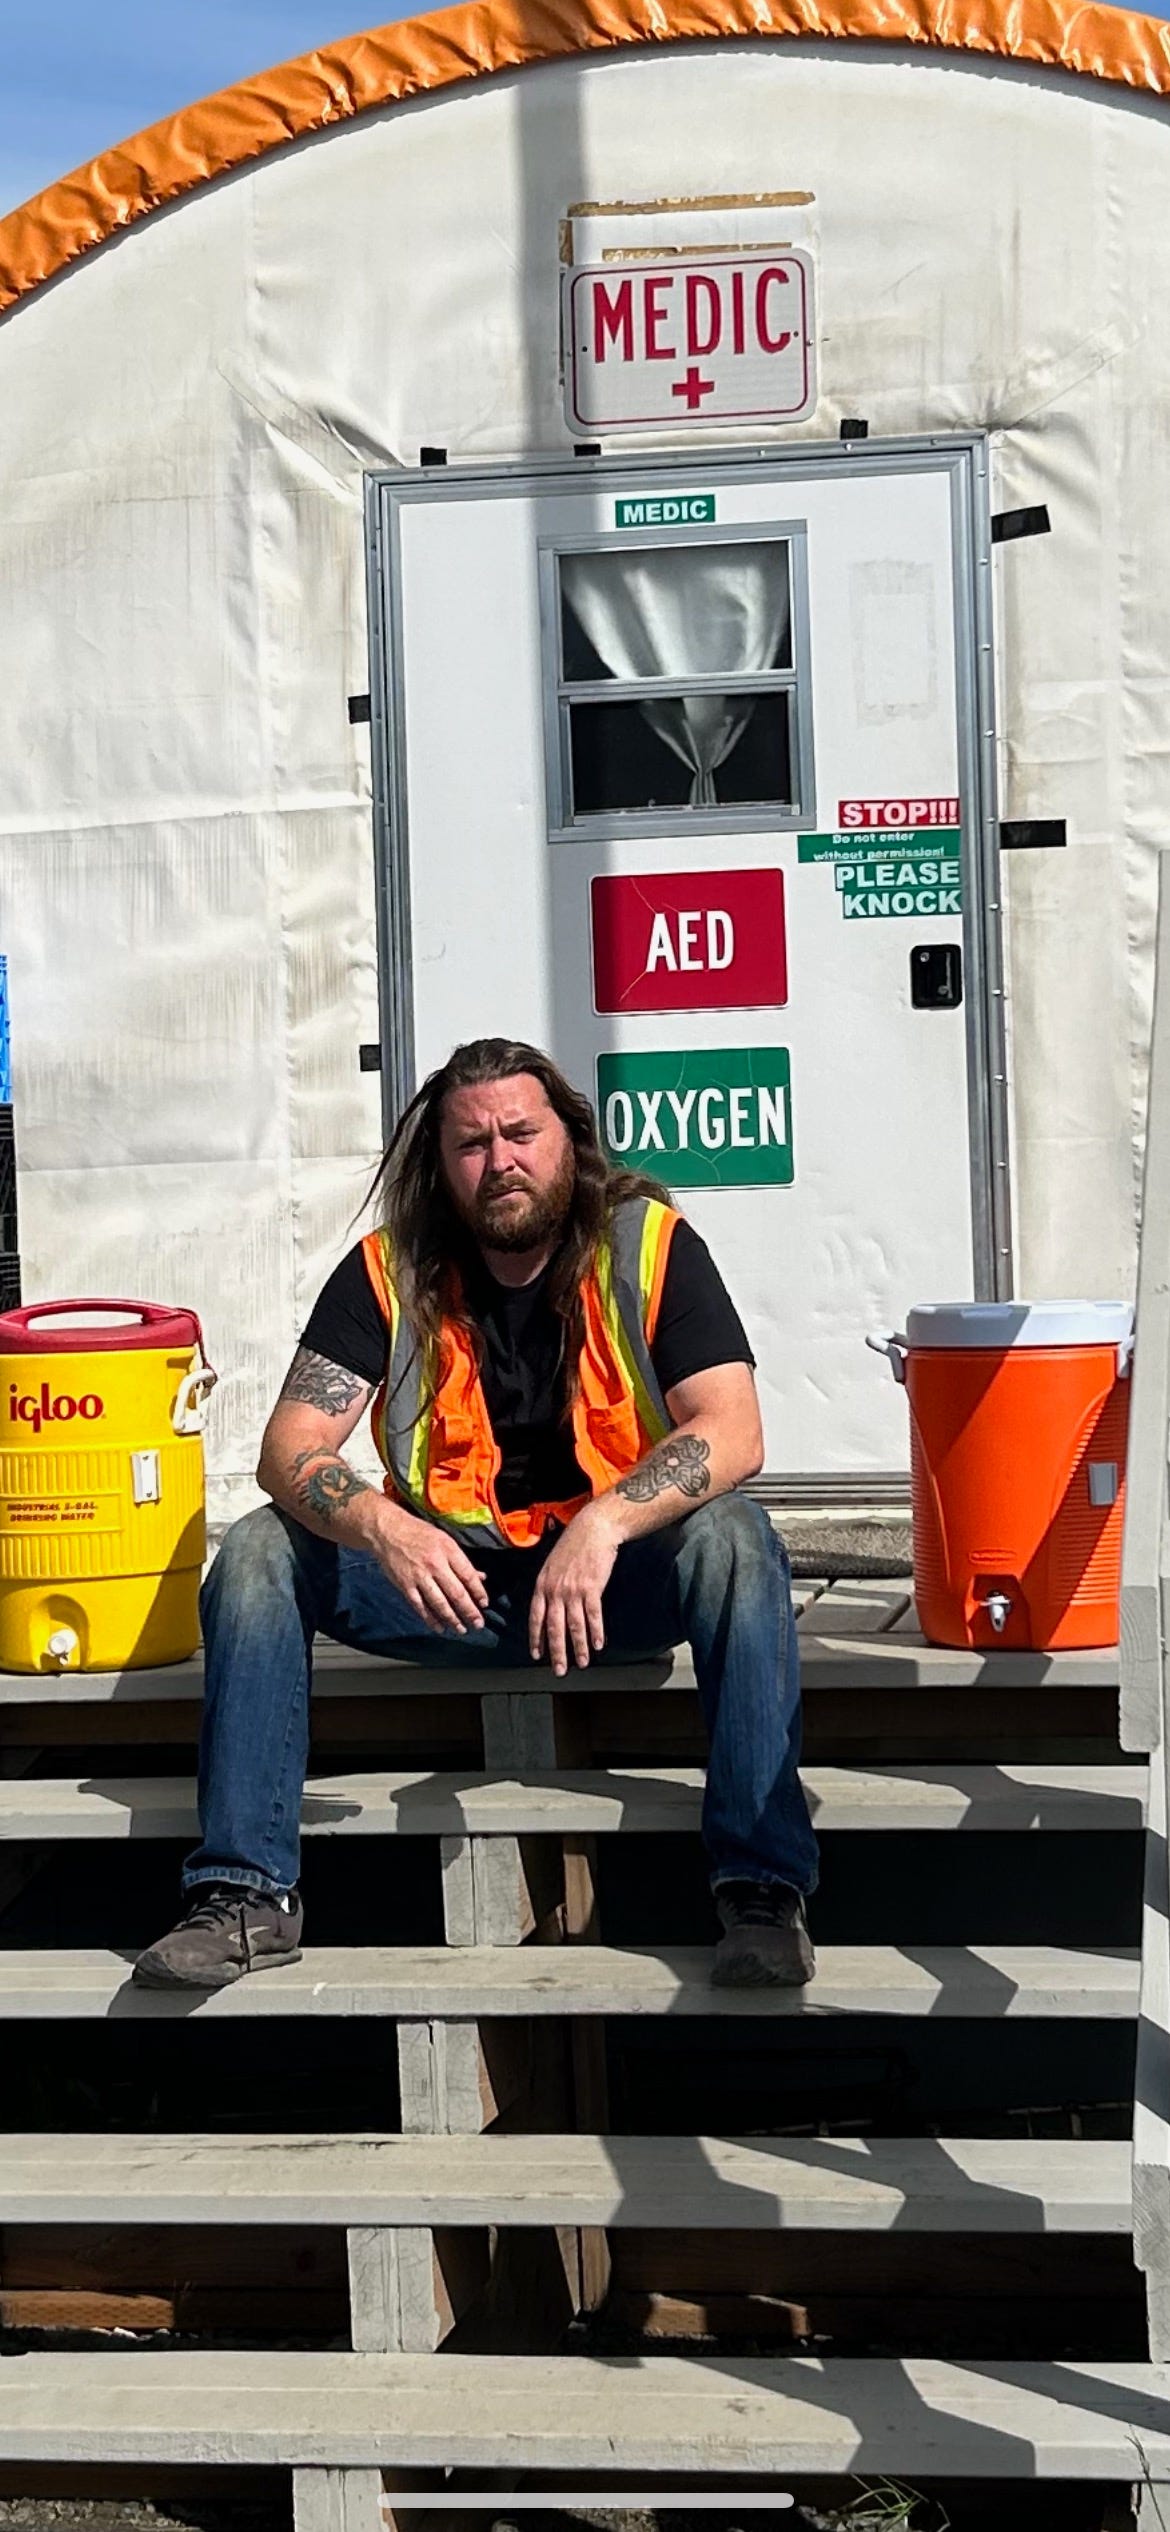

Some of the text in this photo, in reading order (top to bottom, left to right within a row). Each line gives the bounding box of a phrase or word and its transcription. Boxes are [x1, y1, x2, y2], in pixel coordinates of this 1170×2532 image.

[592, 267, 791, 364] MEDIC
[623, 500, 708, 523] MEDIC
[843, 801, 958, 826] STOP!!!
[832, 832, 915, 844] Do not enter
[813, 846, 945, 862] without permission!
[836, 861, 960, 889] PLEASE
[844, 890, 962, 916] KNOCK
[645, 909, 735, 972] AED
[605, 1085, 788, 1151] OXYGEN
[9, 1382, 104, 1434] igloo
